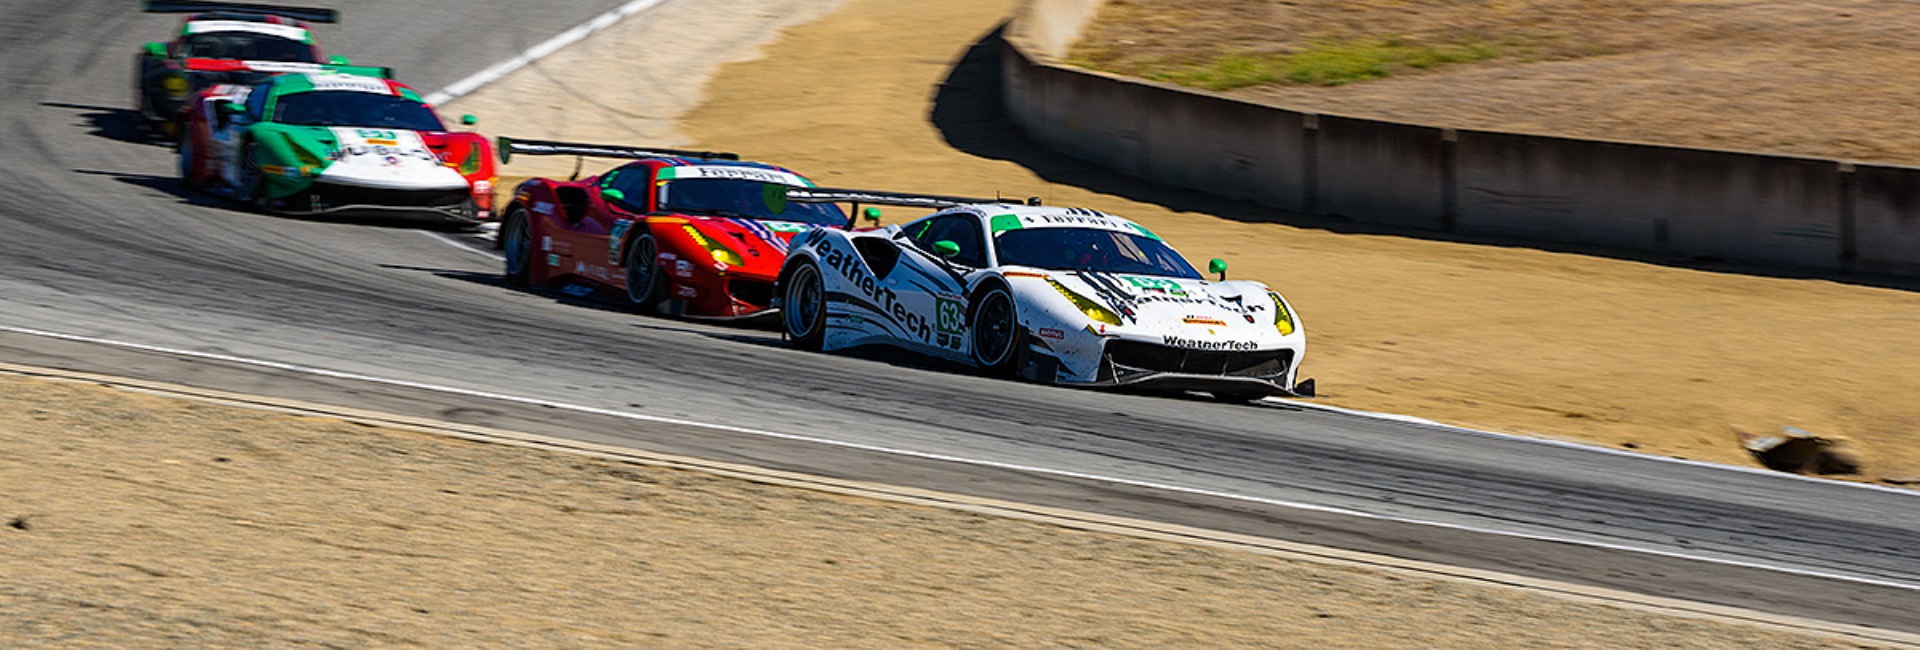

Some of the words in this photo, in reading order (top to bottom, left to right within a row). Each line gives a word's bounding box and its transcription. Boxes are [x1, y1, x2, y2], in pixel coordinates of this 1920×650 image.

[805, 227, 931, 344] WeatherTech
[940, 300, 959, 331] 63
[1164, 335, 1258, 350] WeatherTech
